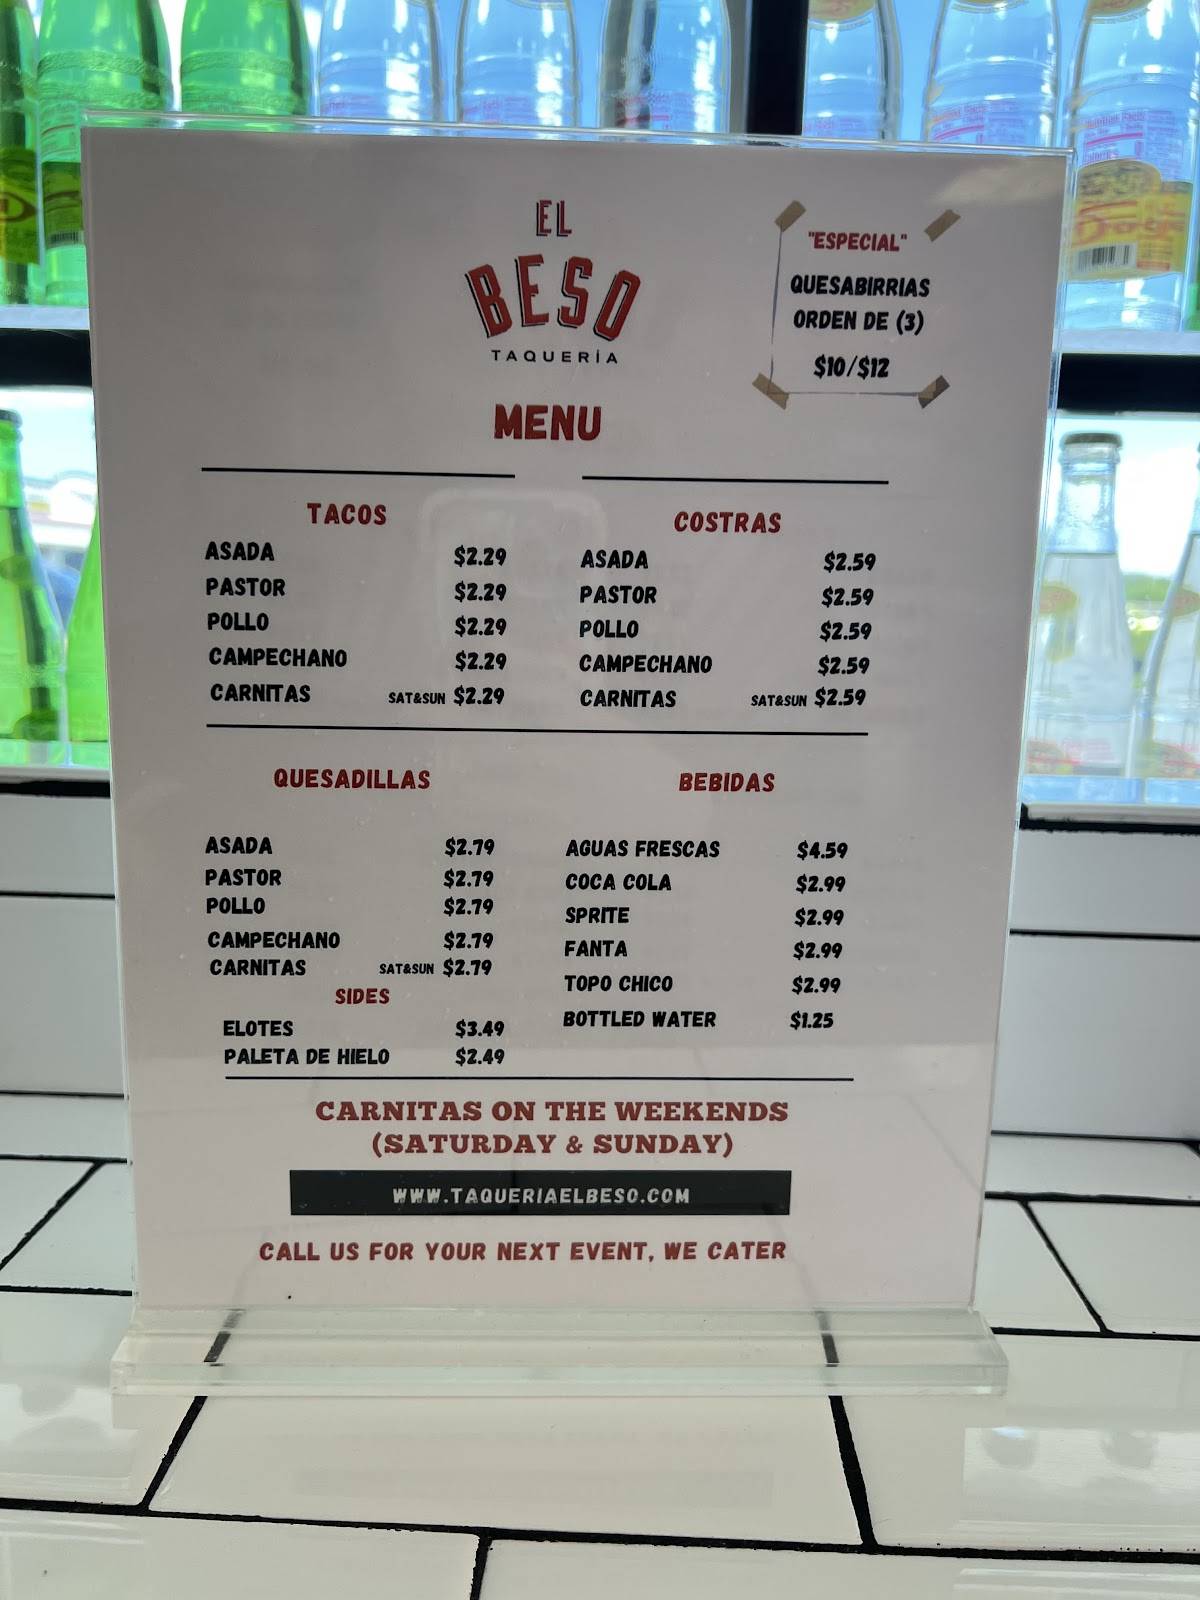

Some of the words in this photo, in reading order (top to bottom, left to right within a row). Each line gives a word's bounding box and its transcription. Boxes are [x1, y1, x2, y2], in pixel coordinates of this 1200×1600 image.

[535, 199, 573, 238] EL
[808, 231, 908, 253] "ESPECIAL"
[790, 273, 931, 298] QUESABIRRIAS
[463, 253, 642, 343] BESO
[793, 308, 858, 331] ORDEN
[863, 311, 890, 331] DE
[895, 309, 925, 337] (3)
[490, 348, 618, 365] TAQUERÍA
[813, 353, 890, 381] $10/$12
[493, 403, 602, 442] MENU
[306, 502, 387, 526] TACOS
[673, 510, 782, 534] COSTRAS
[204, 540, 275, 562] ASADA
[453, 544, 507, 568] $2.29
[580, 548, 649, 570] ASADA
[823, 549, 877, 574] $2.59
[205, 576, 286, 597] PASTOR
[454, 579, 507, 604] $2.29
[579, 584, 658, 605] PASTOR
[821, 585, 875, 609] $2.59
[207, 611, 270, 632] POLLO
[454, 614, 508, 638] $2.29
[579, 618, 640, 639] POLLO
[818, 619, 873, 643] $2.59
[208, 646, 348, 668] CAMPECHANO
[454, 649, 507, 673] $2.29
[578, 653, 713, 674] CAMPECHANO
[817, 654, 871, 678] $2.59
[210, 682, 311, 704] CARNITAS
[388, 691, 446, 705] SAT&SUN
[453, 684, 505, 707] $2.29
[579, 689, 677, 708] CARNITAS
[750, 694, 808, 708] SAT&SUN
[813, 685, 867, 709] $2.59
[273, 767, 431, 790] QUESADILLAS
[678, 772, 776, 793] BEBIDAS
[204, 835, 273, 855] ASADA
[444, 836, 495, 858] $2.79
[565, 839, 629, 858] AGUAS
[634, 839, 721, 859] FRESCAS
[796, 839, 849, 862] $4.59
[204, 868, 282, 887] PASTOR
[442, 867, 494, 890] $2.79
[565, 872, 617, 891] COCA
[622, 873, 672, 892] COLA
[795, 873, 846, 895] $2.99
[206, 896, 266, 915] POLLO
[442, 895, 494, 918] $2.79
[564, 906, 630, 924] SPRITE
[793, 906, 845, 928] $2.99
[207, 930, 341, 950] CAMPECHANO
[442, 929, 494, 952] $2.79
[564, 939, 628, 958] FANTA
[792, 939, 843, 961] $2.99
[209, 958, 307, 977] CARNITAS
[378, 962, 435, 975] SAT&SUN
[442, 956, 493, 979] $2.79
[334, 987, 390, 1005] SIDES
[563, 974, 613, 992] TOPO
[618, 975, 674, 993] CHICO
[791, 974, 842, 996] $2.99
[223, 1019, 294, 1037] ELOTES
[454, 1018, 505, 1040] $3.49
[562, 1009, 646, 1028] BOTTLED
[651, 1010, 717, 1028] WATER
[789, 1010, 834, 1031] $1.25
[224, 1047, 300, 1065] PALETA
[305, 1047, 331, 1065] DE
[336, 1047, 390, 1065] HIELO
[455, 1046, 505, 1068] $2.49
[315, 1100, 482, 1122] CARNITAS
[491, 1100, 536, 1122] ON
[544, 1101, 606, 1122] THE
[613, 1101, 789, 1122] WEEKENDS
[372, 1131, 557, 1158] (SATURDAY
[565, 1135, 583, 1154] &
[593, 1131, 733, 1158] SUNDAY)
[392, 1187, 690, 1204] WWW.TAQUERIAELBESO.COM
[258, 1241, 321, 1262] CALL
[329, 1241, 360, 1262] US
[369, 1241, 414, 1261] FOR
[425, 1241, 487, 1261] YOUR
[496, 1241, 561, 1261] NEXT
[569, 1241, 655, 1263] EVENT,
[664, 1241, 698, 1261] WE
[707, 1240, 787, 1261] CATER
